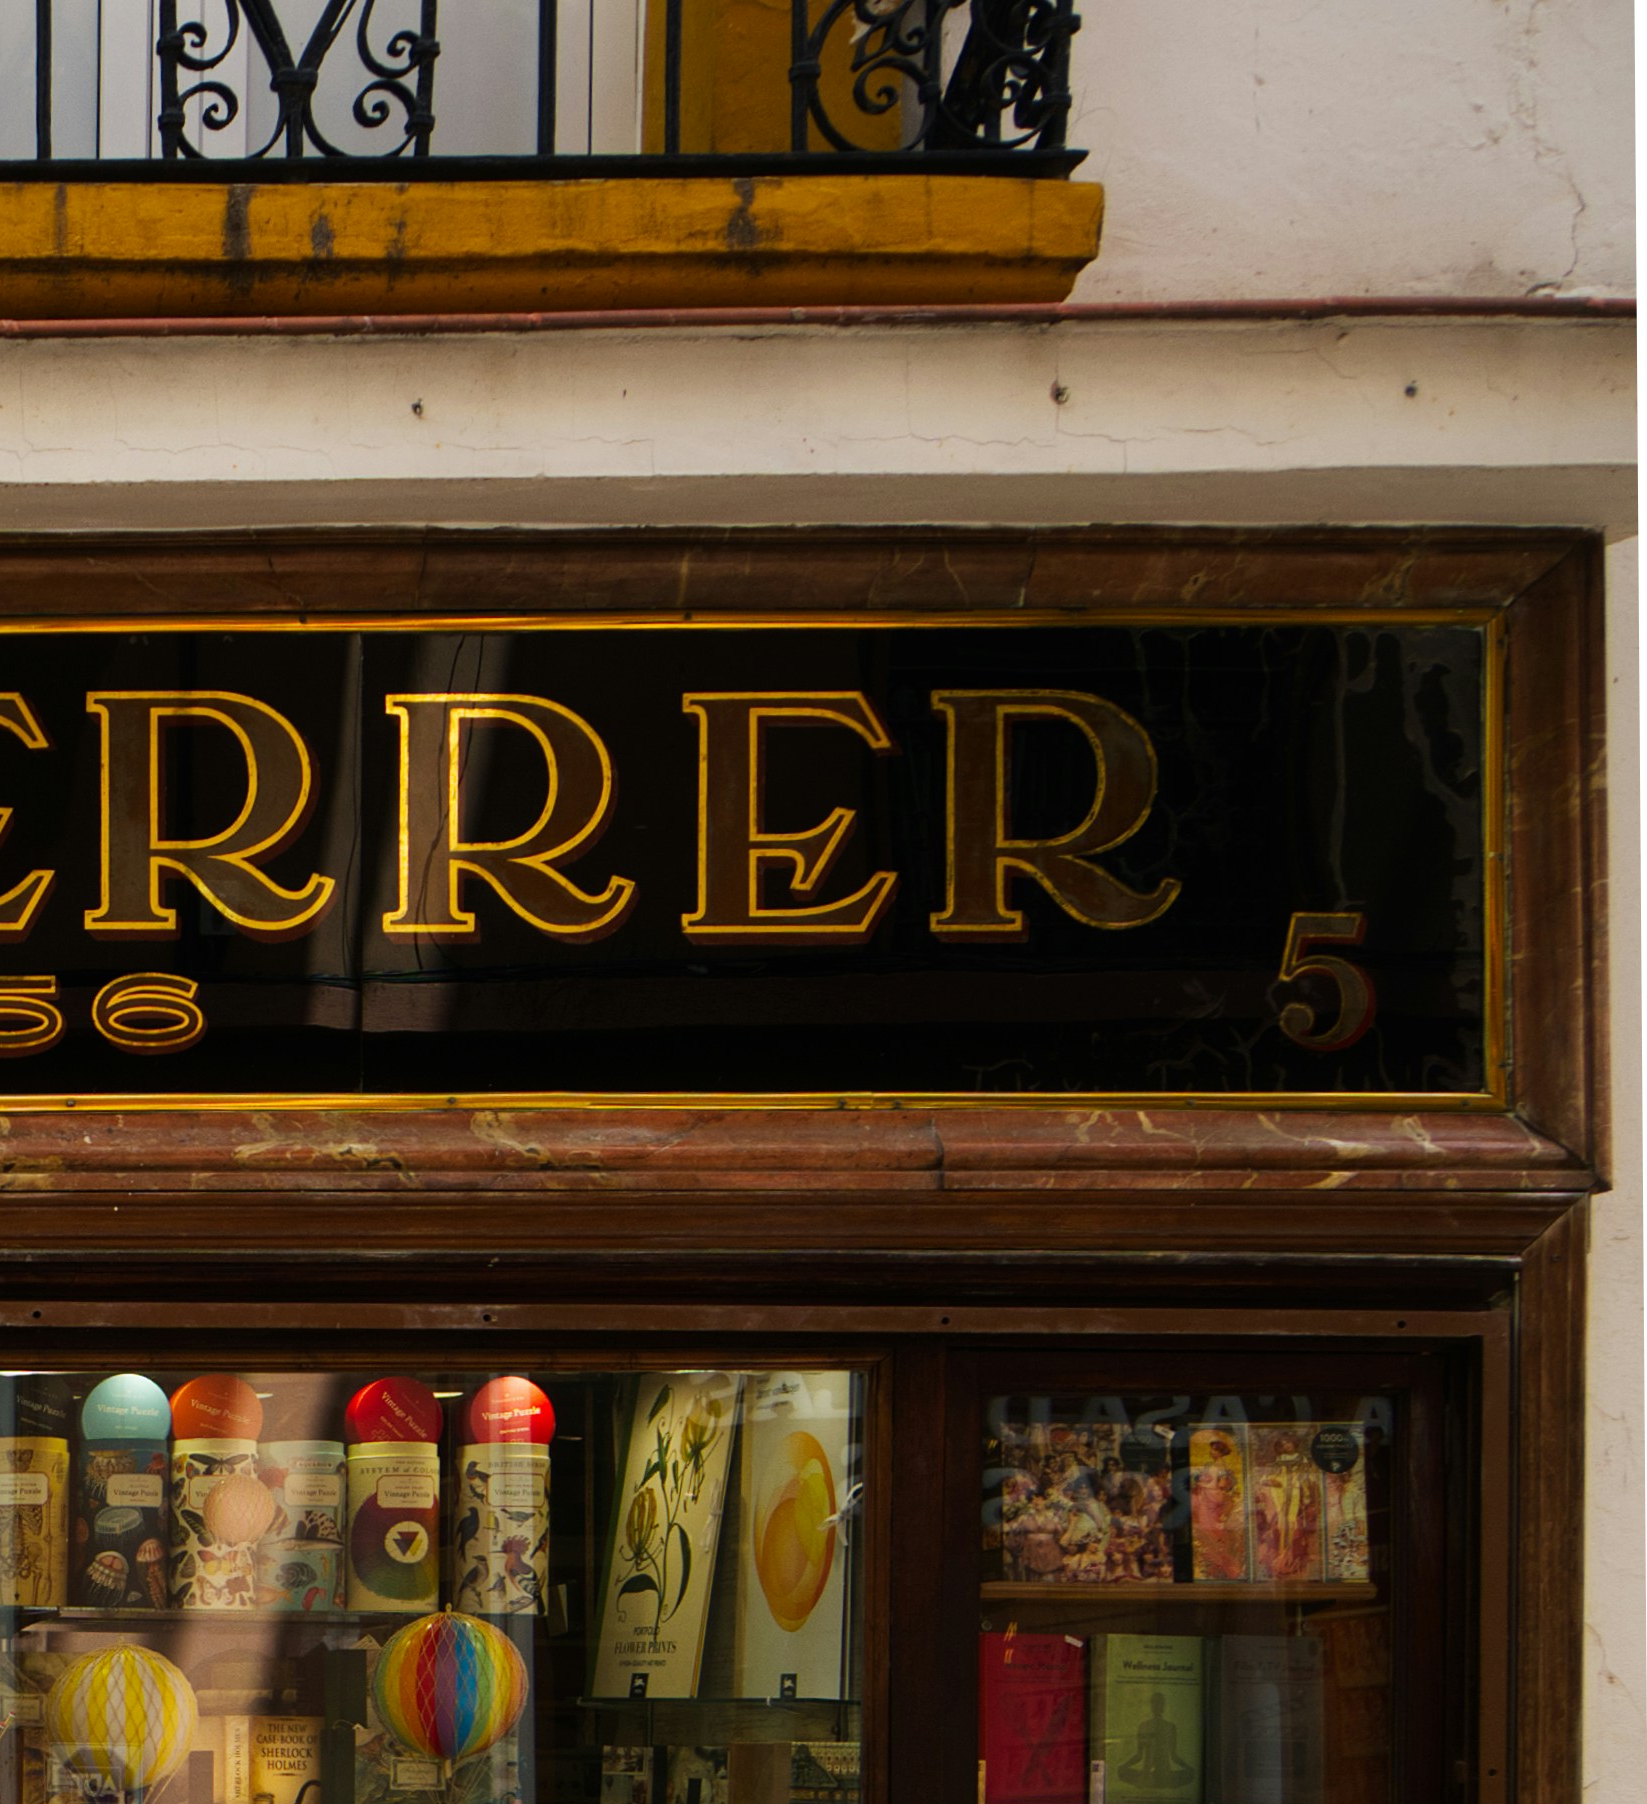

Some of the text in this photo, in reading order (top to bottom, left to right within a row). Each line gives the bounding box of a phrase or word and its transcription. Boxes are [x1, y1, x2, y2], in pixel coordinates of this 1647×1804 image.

[1277, 911, 1377, 1051] 5
[17, 1394, 42, 1411] Vintage
[190, 1398, 221, 1417] Vintage
[97, 1403, 160, 1417] Vintage Puzzle
[381, 1390, 406, 1419] Vintage
[405, 1414, 429, 1440] Puzzle
[481, 1405, 542, 1421] Vintage Puzzle
[113, 1488, 139, 1498] Vintage
[384, 1490, 406, 1499] Vintage
[614, 1640, 677, 1655] FLOWER PRINTS
[1123, 1660, 1195, 1673] Wellness Journal
[266, 1723, 308, 1733] THE NEW
[261, 1747, 313, 1759] SHERLOCK
[267, 1760, 308, 1771] HOLMES
